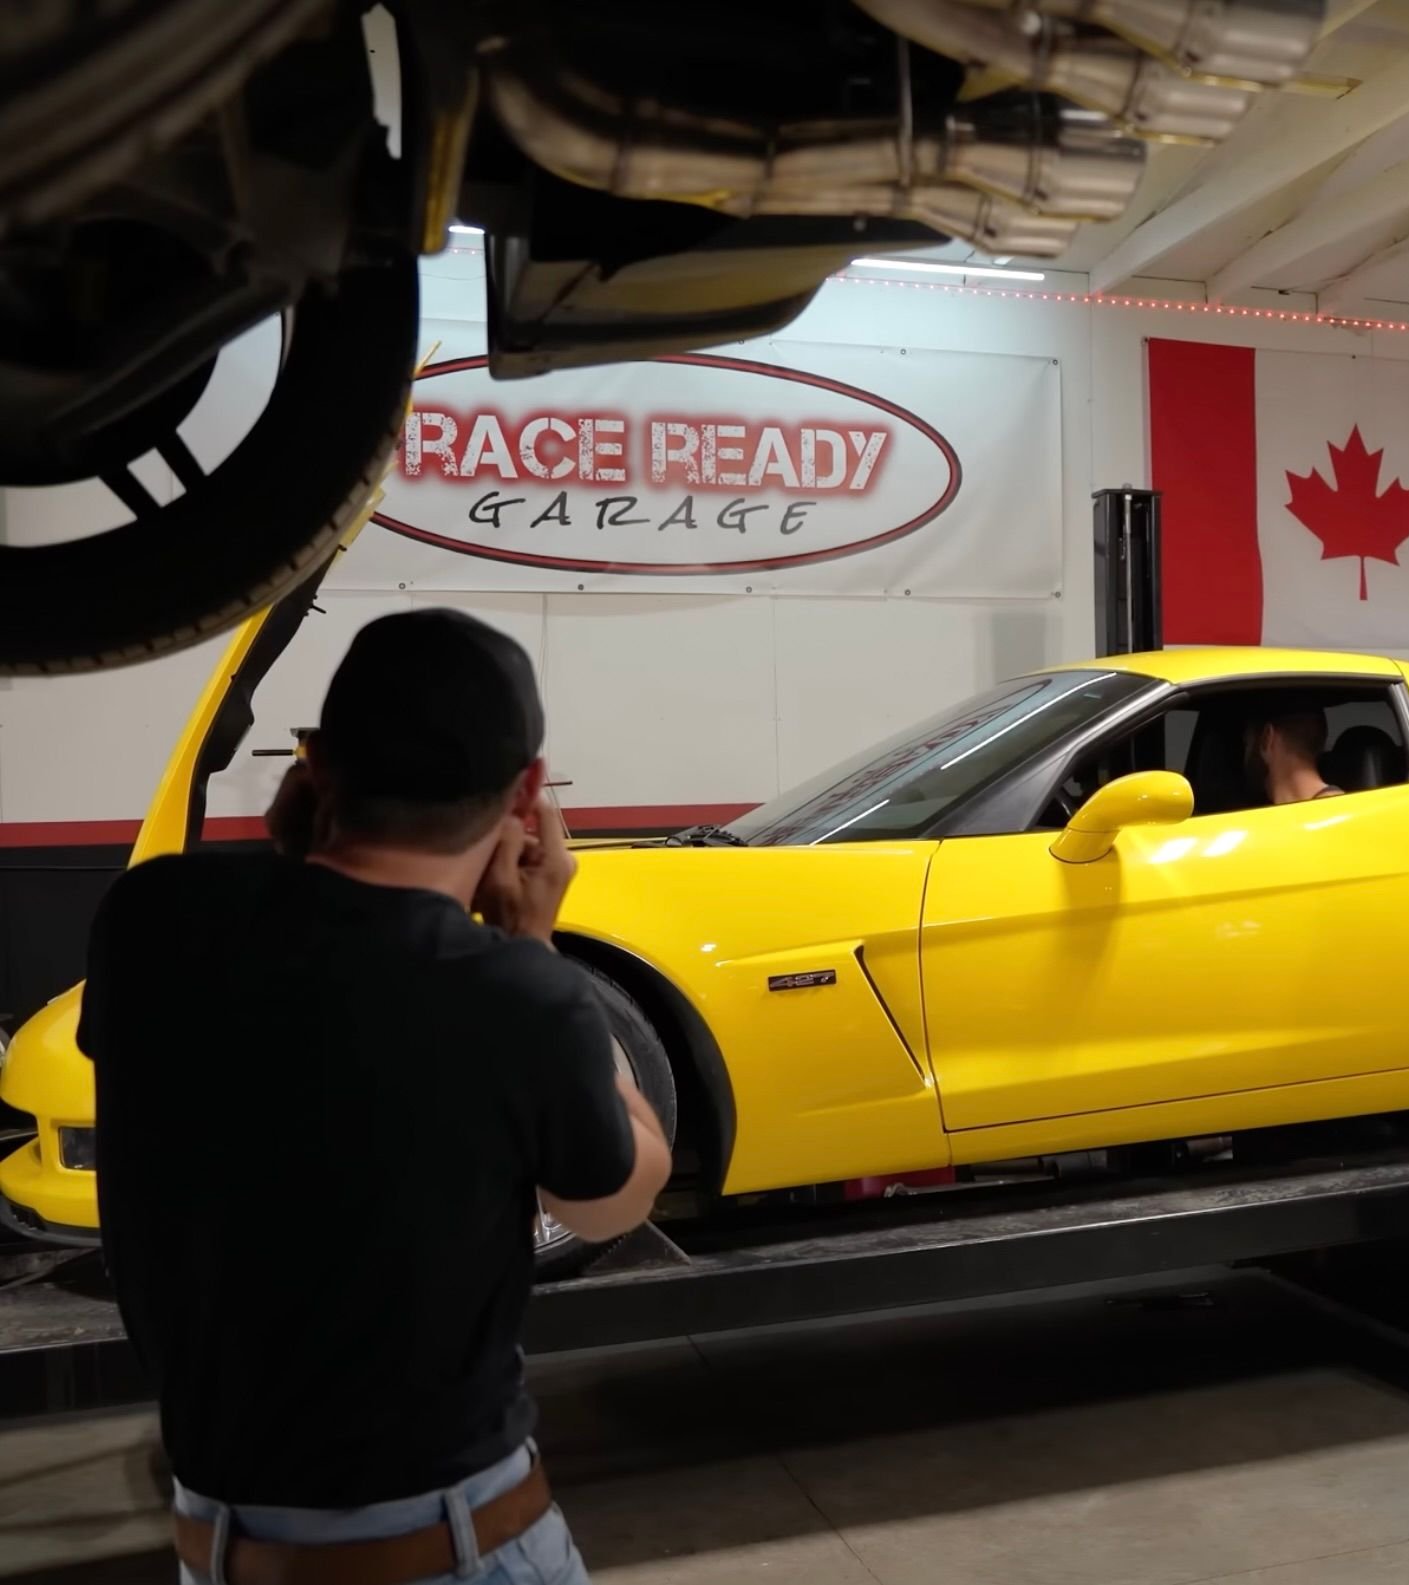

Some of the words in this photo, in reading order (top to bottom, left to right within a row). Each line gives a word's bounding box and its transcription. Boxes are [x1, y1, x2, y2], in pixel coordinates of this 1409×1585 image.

[405, 411, 626, 483] RACE
[651, 421, 888, 491] READY
[468, 491, 818, 537] GARAGE
